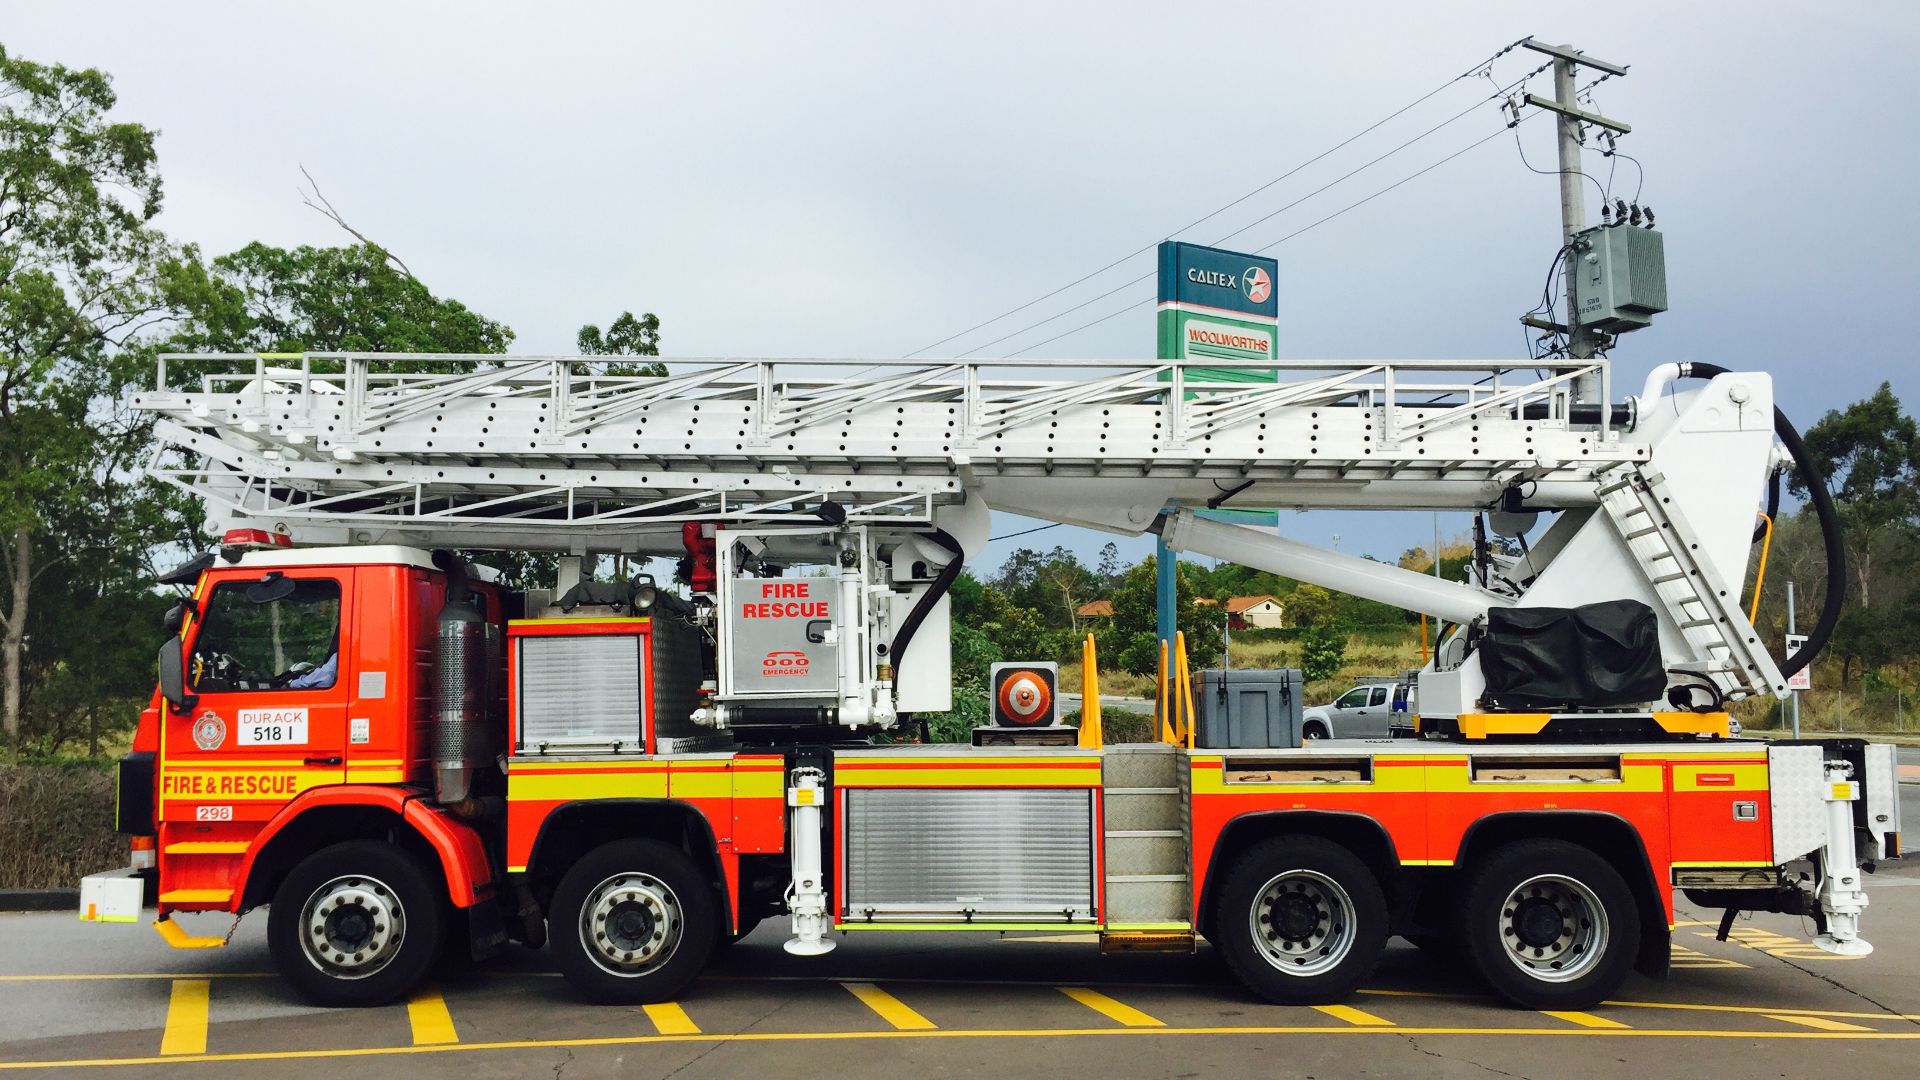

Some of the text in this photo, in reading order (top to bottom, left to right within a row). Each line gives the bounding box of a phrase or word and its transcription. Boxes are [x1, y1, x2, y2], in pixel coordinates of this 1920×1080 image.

[1187, 268, 1237, 289] CALTEX
[1188, 328, 1268, 352] WOOLWORTHS
[762, 583, 809, 598] FIRE
[743, 602, 828, 618] RESCUE
[763, 668, 809, 676] EMERGENCY
[243, 711, 302, 724] DURACK
[163, 776, 297, 794] FIRE & RESCUE
[199, 808, 230, 820] 298
